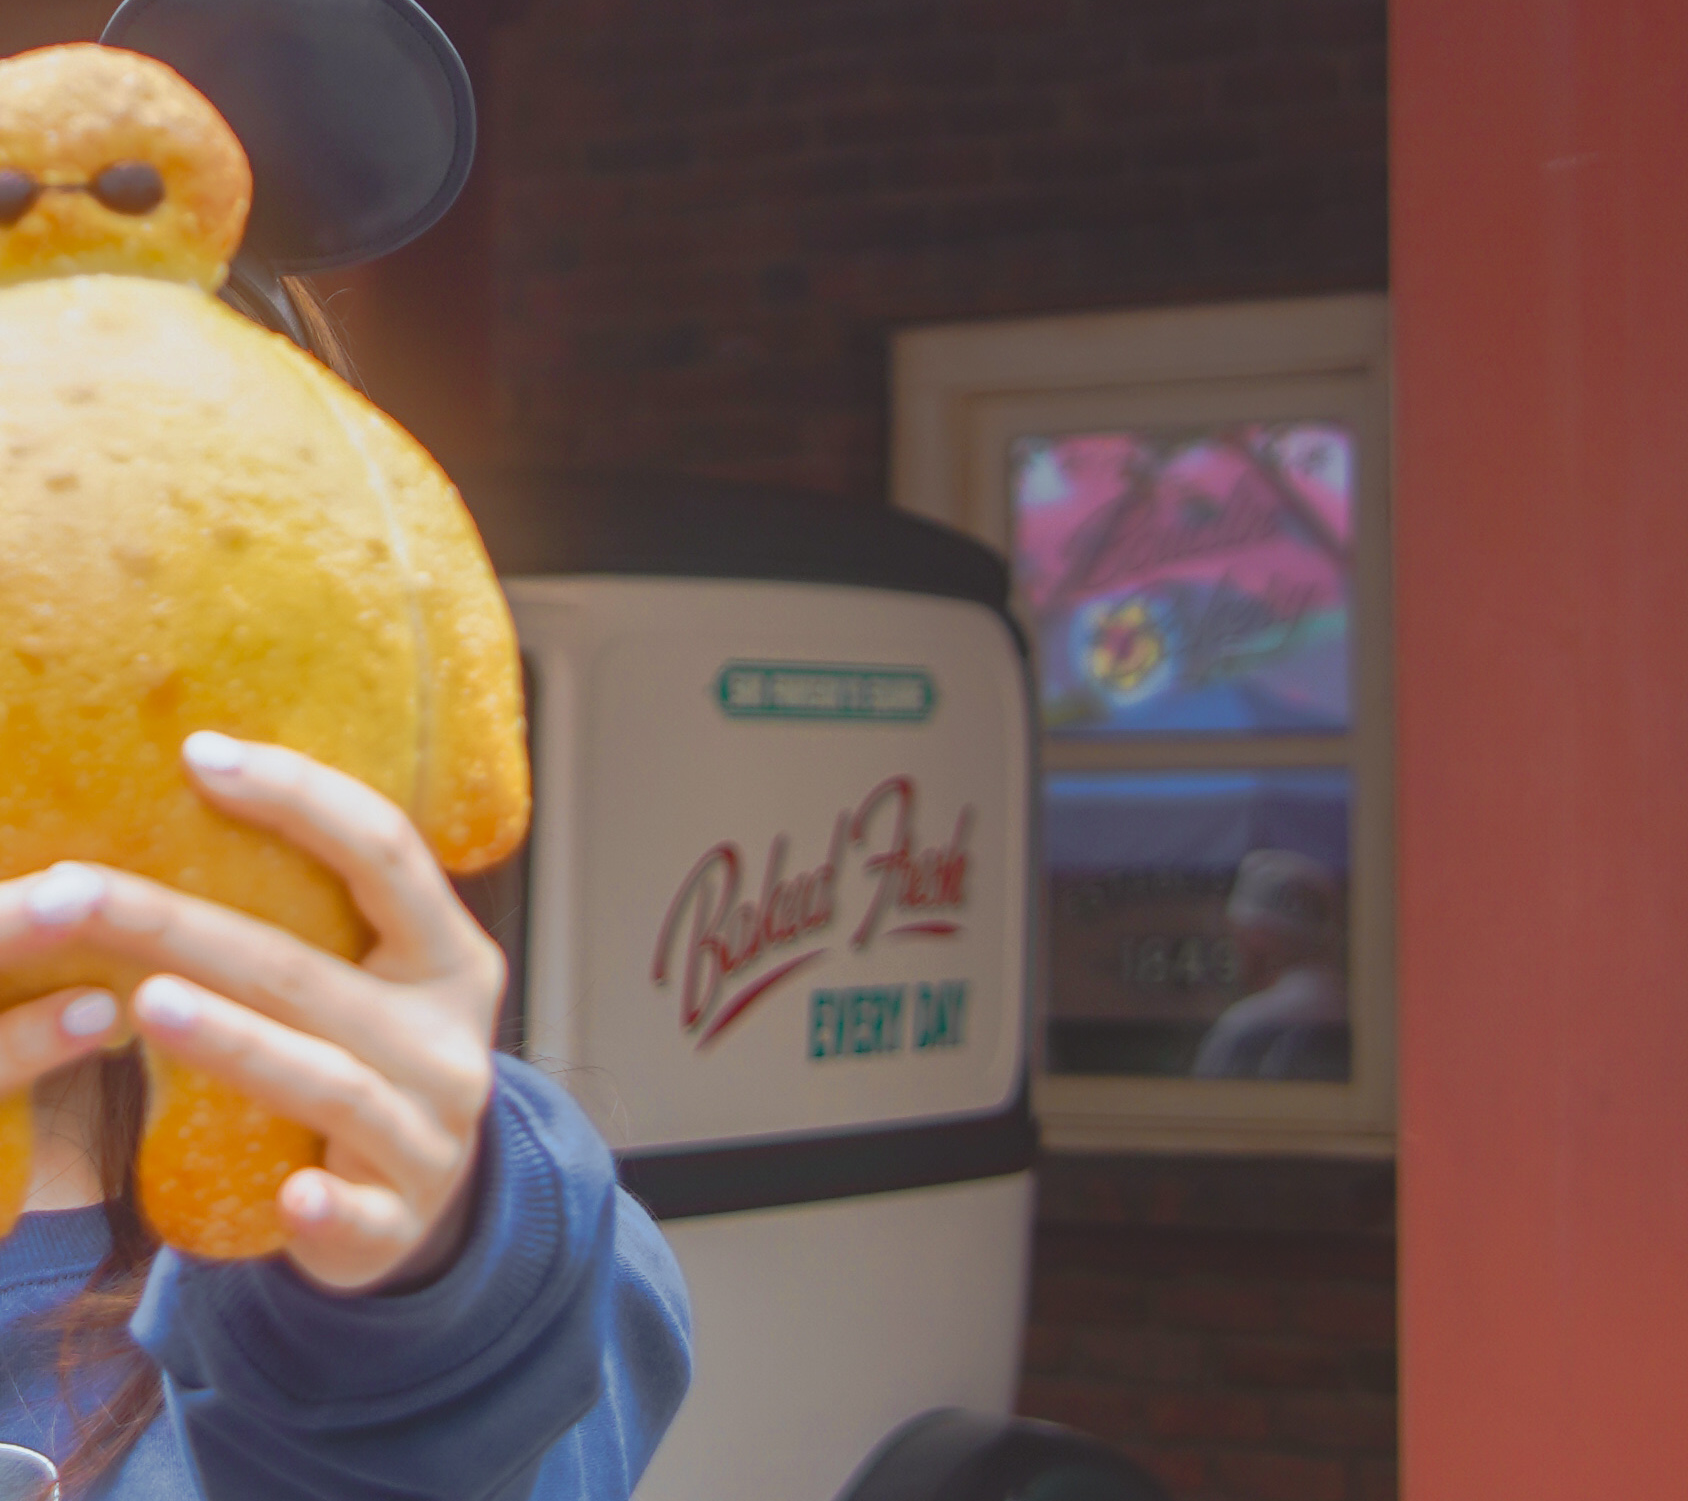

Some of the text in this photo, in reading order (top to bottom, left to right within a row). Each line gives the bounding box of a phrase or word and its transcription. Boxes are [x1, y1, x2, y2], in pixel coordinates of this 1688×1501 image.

[651, 772, 978, 1033] Baked Fresh
[809, 978, 969, 1059] EVERY DAY
